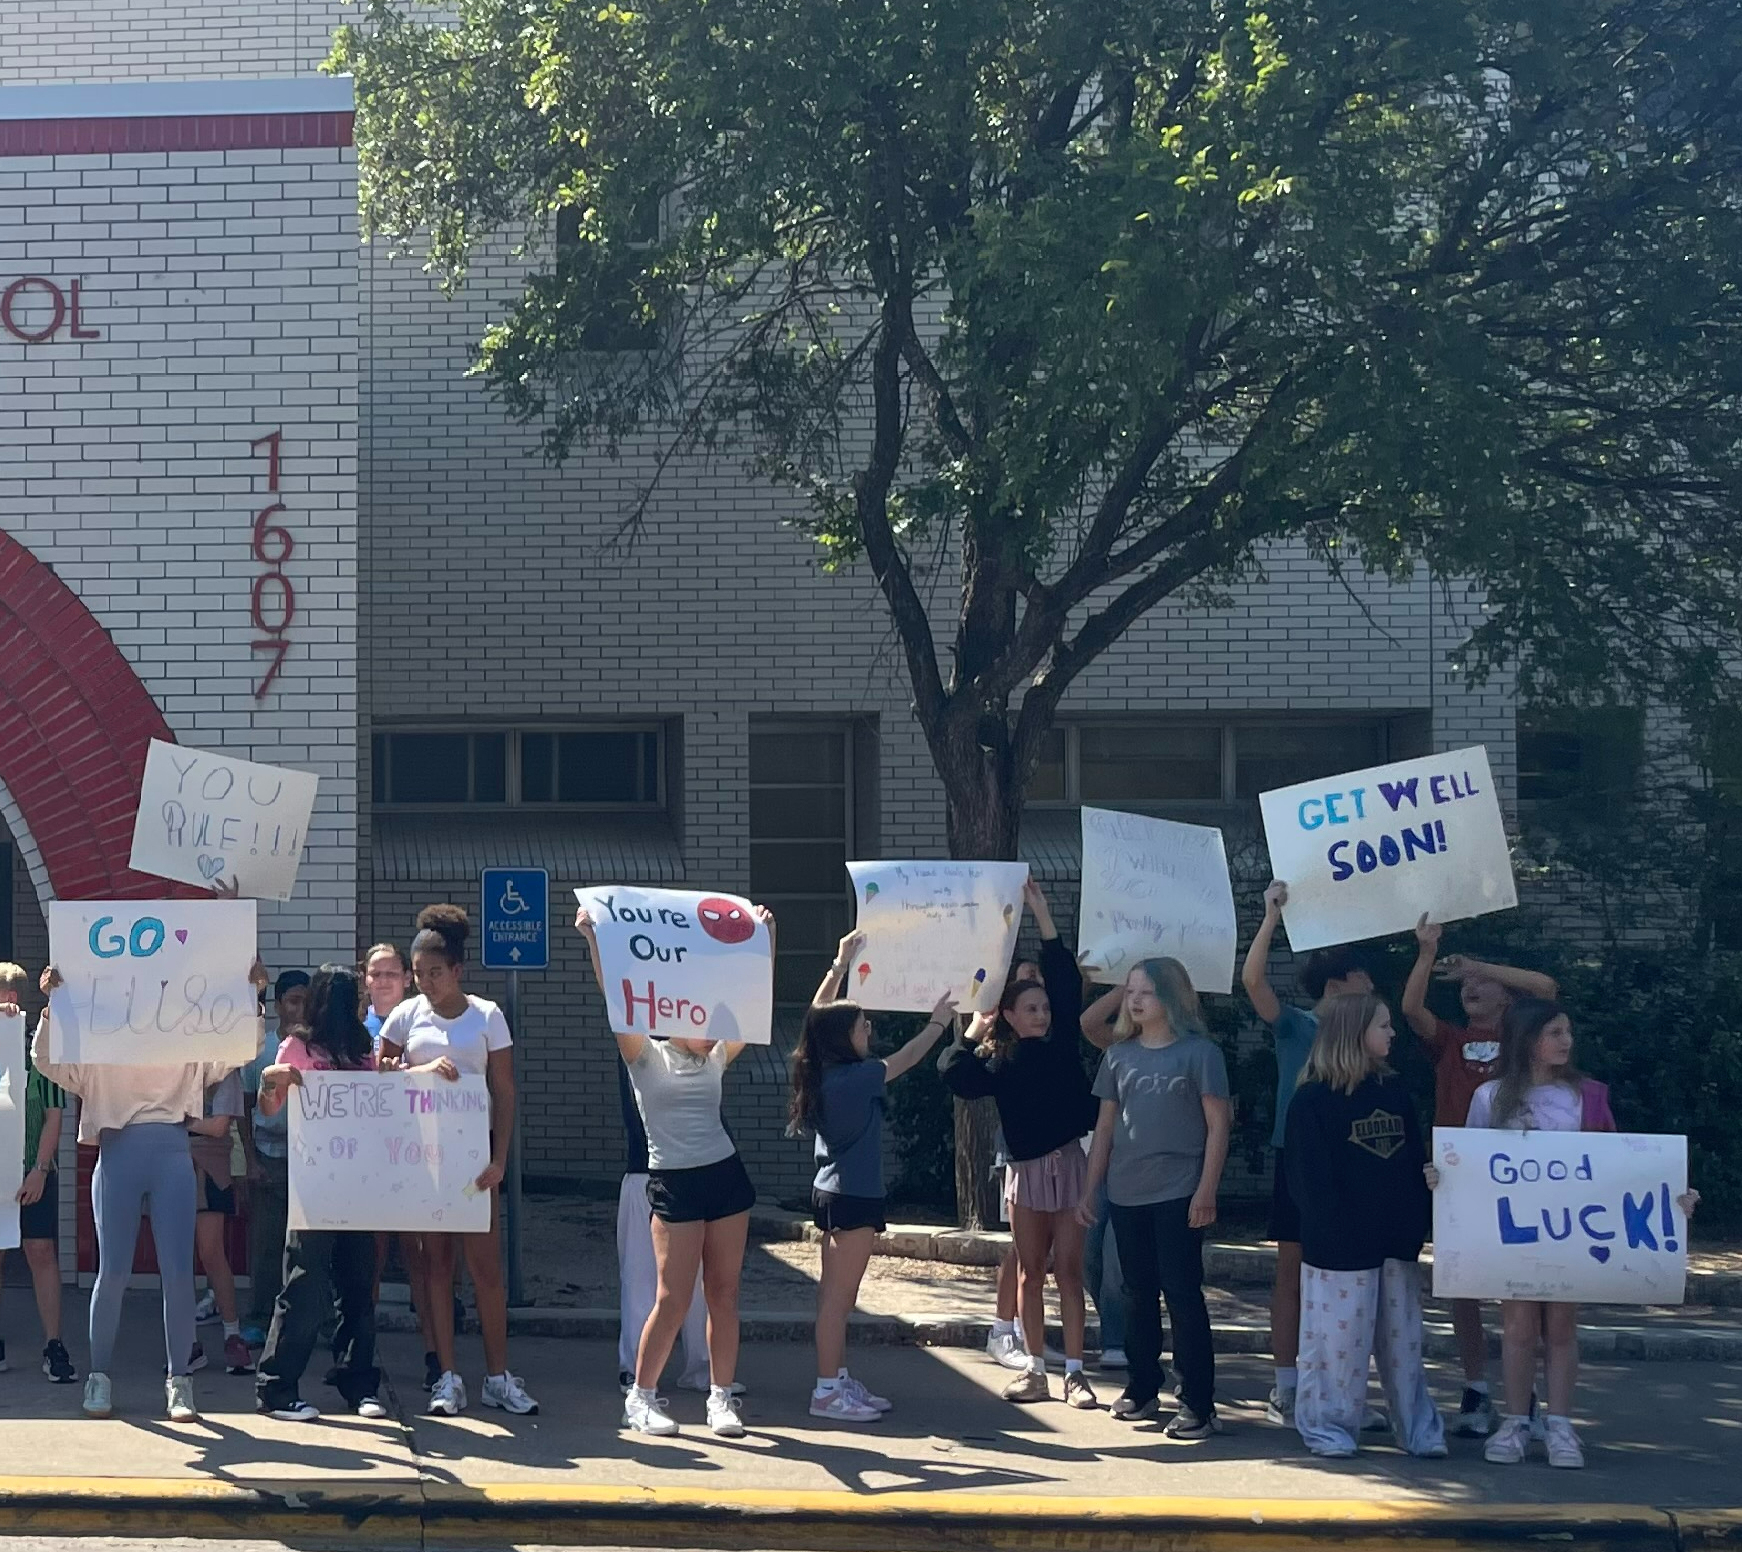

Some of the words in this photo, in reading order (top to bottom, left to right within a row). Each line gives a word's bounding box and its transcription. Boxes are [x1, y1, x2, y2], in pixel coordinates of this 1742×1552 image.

[250, 430, 294, 701] 1607
[171, 755, 281, 806] YOU
[1298, 788, 1366, 830] GET
[1377, 771, 1480, 811] WELL
[162, 800, 298, 856] RULE!!!
[1327, 820, 1447, 881] SOON!
[89, 916, 165, 958] GO
[488, 920, 542, 931] ACCESSIBLE
[492, 932, 538, 942] ENTRANCE
[629, 934, 687, 962] Our
[622, 978, 706, 1030] Hero
[298, 1082, 395, 1120] WE'RE
[404, 1089, 487, 1114] THINKING
[329, 1135, 357, 1160] OF
[384, 1136, 444, 1165] YOU
[1489, 1153, 1593, 1184] Good
[1497, 1182, 1679, 1253] LUCK!
